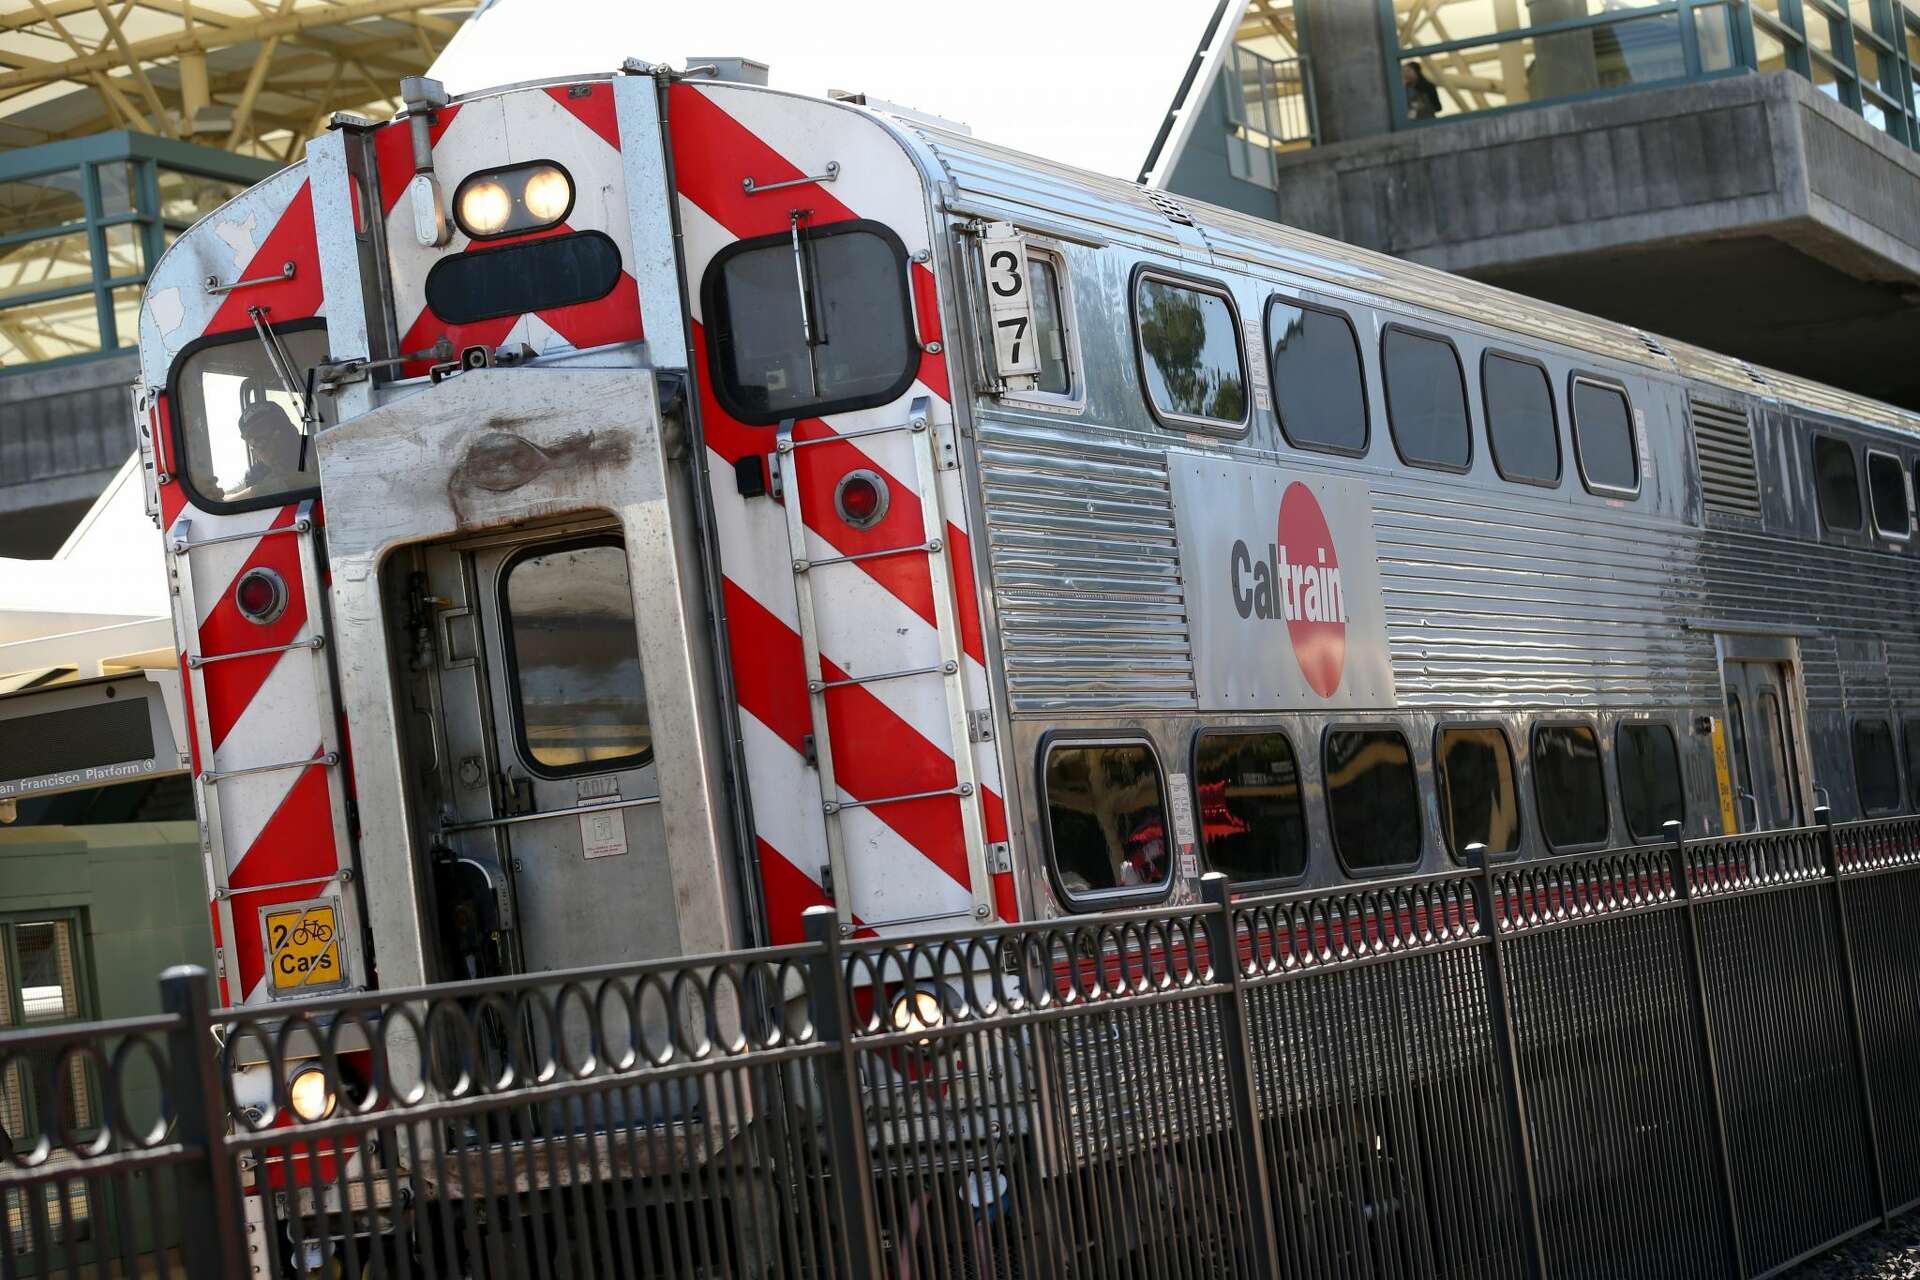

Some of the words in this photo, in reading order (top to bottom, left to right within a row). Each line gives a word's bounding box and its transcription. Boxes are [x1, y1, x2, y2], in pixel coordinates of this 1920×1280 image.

[1231, 539, 1345, 623] Caltrain
[0, 784, 15, 794] an
[20, 774, 80, 791] Francisco
[86, 763, 139, 780] Platform
[273, 924, 289, 949] 2
[280, 953, 332, 974] Cars
